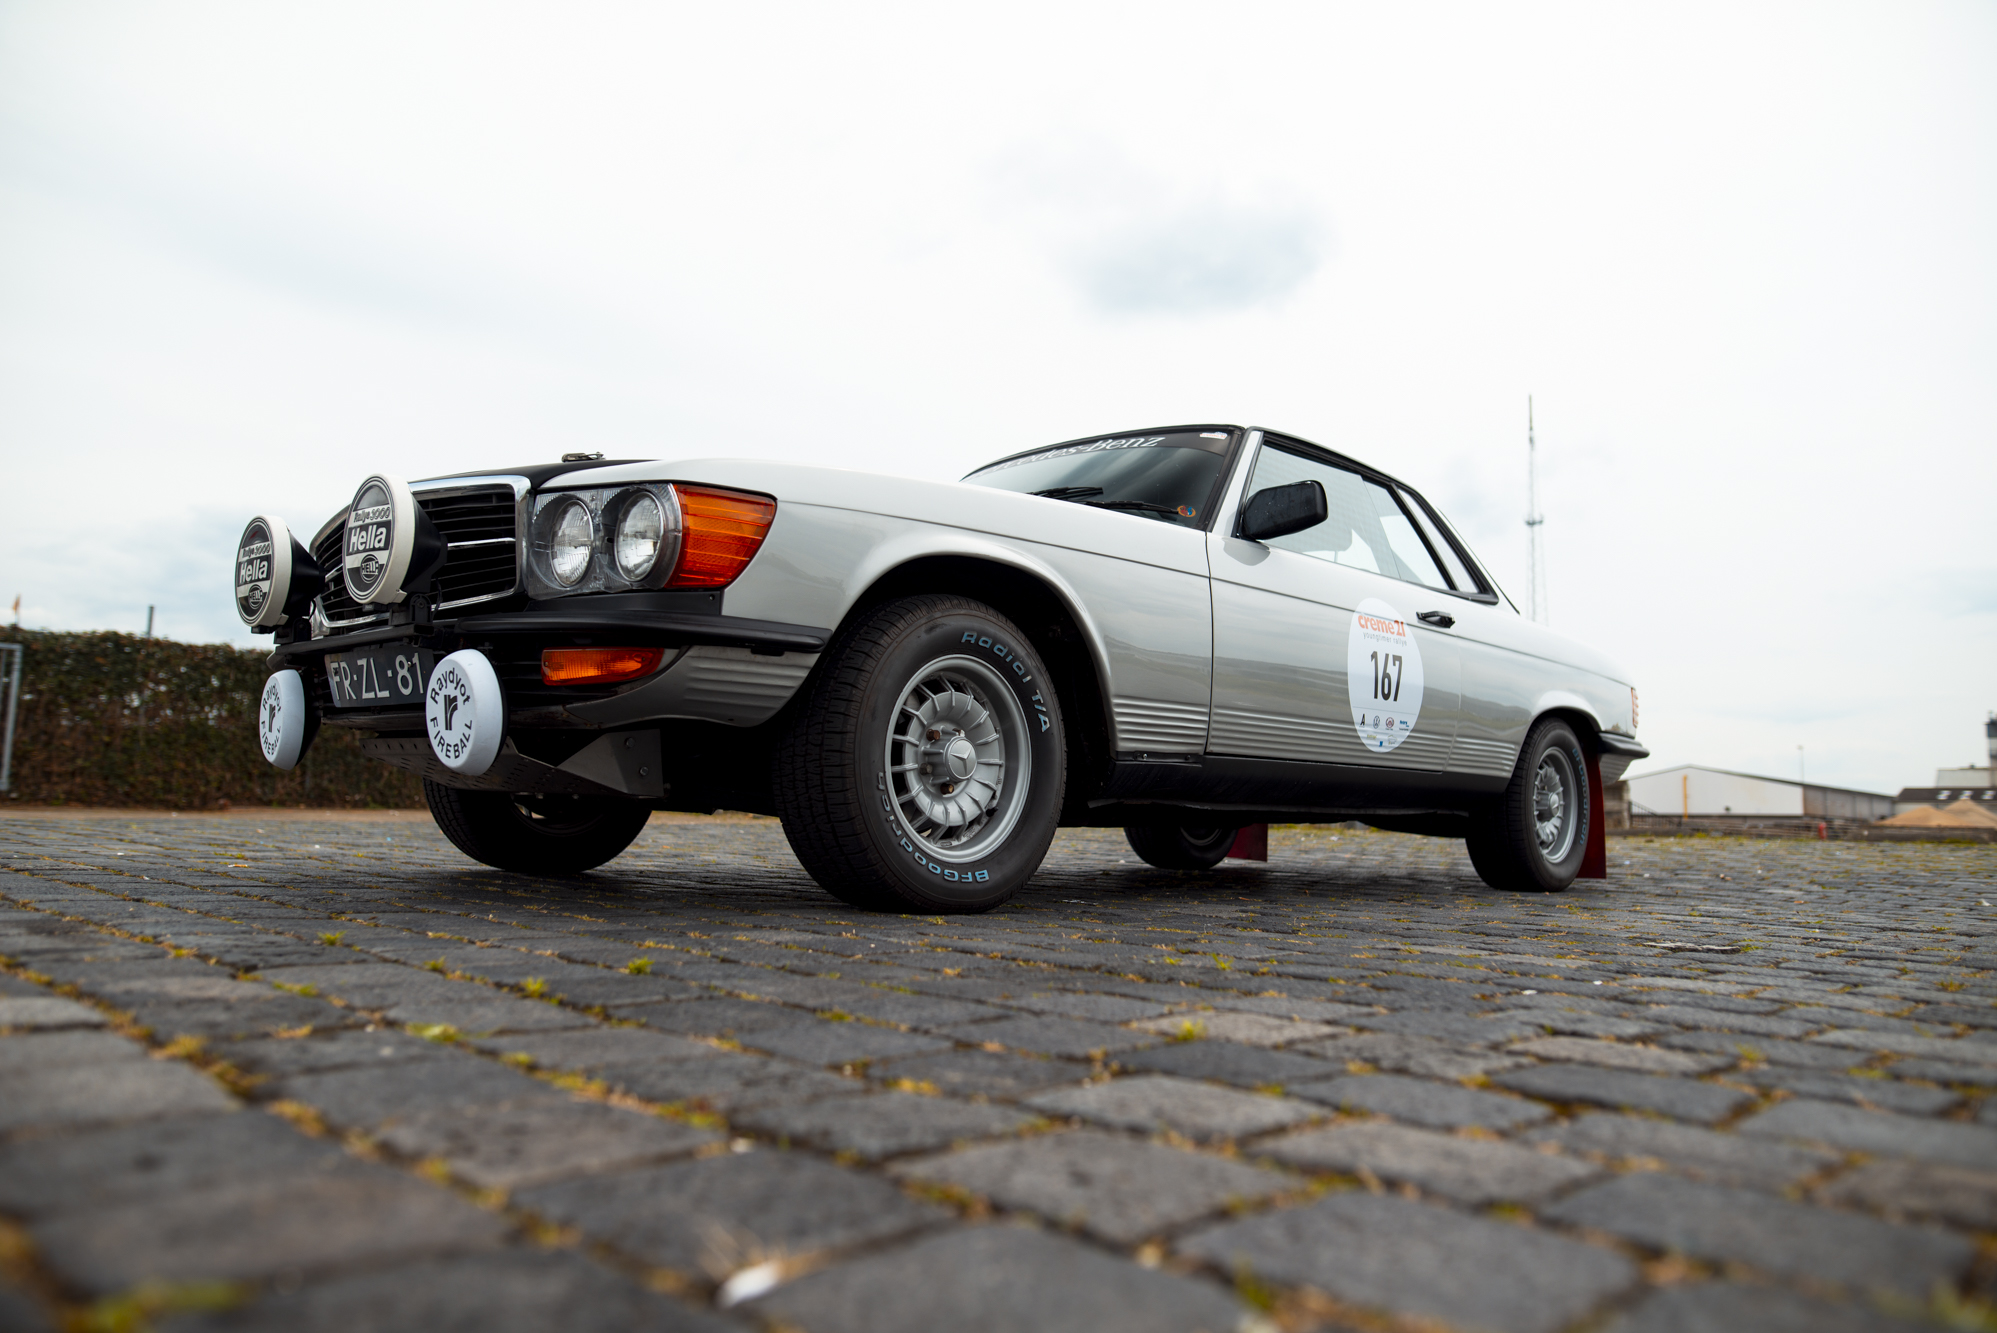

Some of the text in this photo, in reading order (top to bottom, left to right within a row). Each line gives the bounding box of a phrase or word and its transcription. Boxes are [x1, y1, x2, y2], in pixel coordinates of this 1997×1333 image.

[349, 525, 387, 553] Hella
[240, 558, 268, 584] Hella
[430, 667, 471, 705] Raydyot
[961, 632, 1050, 732] Radial T/A
[1371, 651, 1402, 702] 167
[261, 720, 281, 756] FIREBALL
[430, 717, 473, 759] FIREBALL
[877, 771, 989, 883] BFGoodrich
